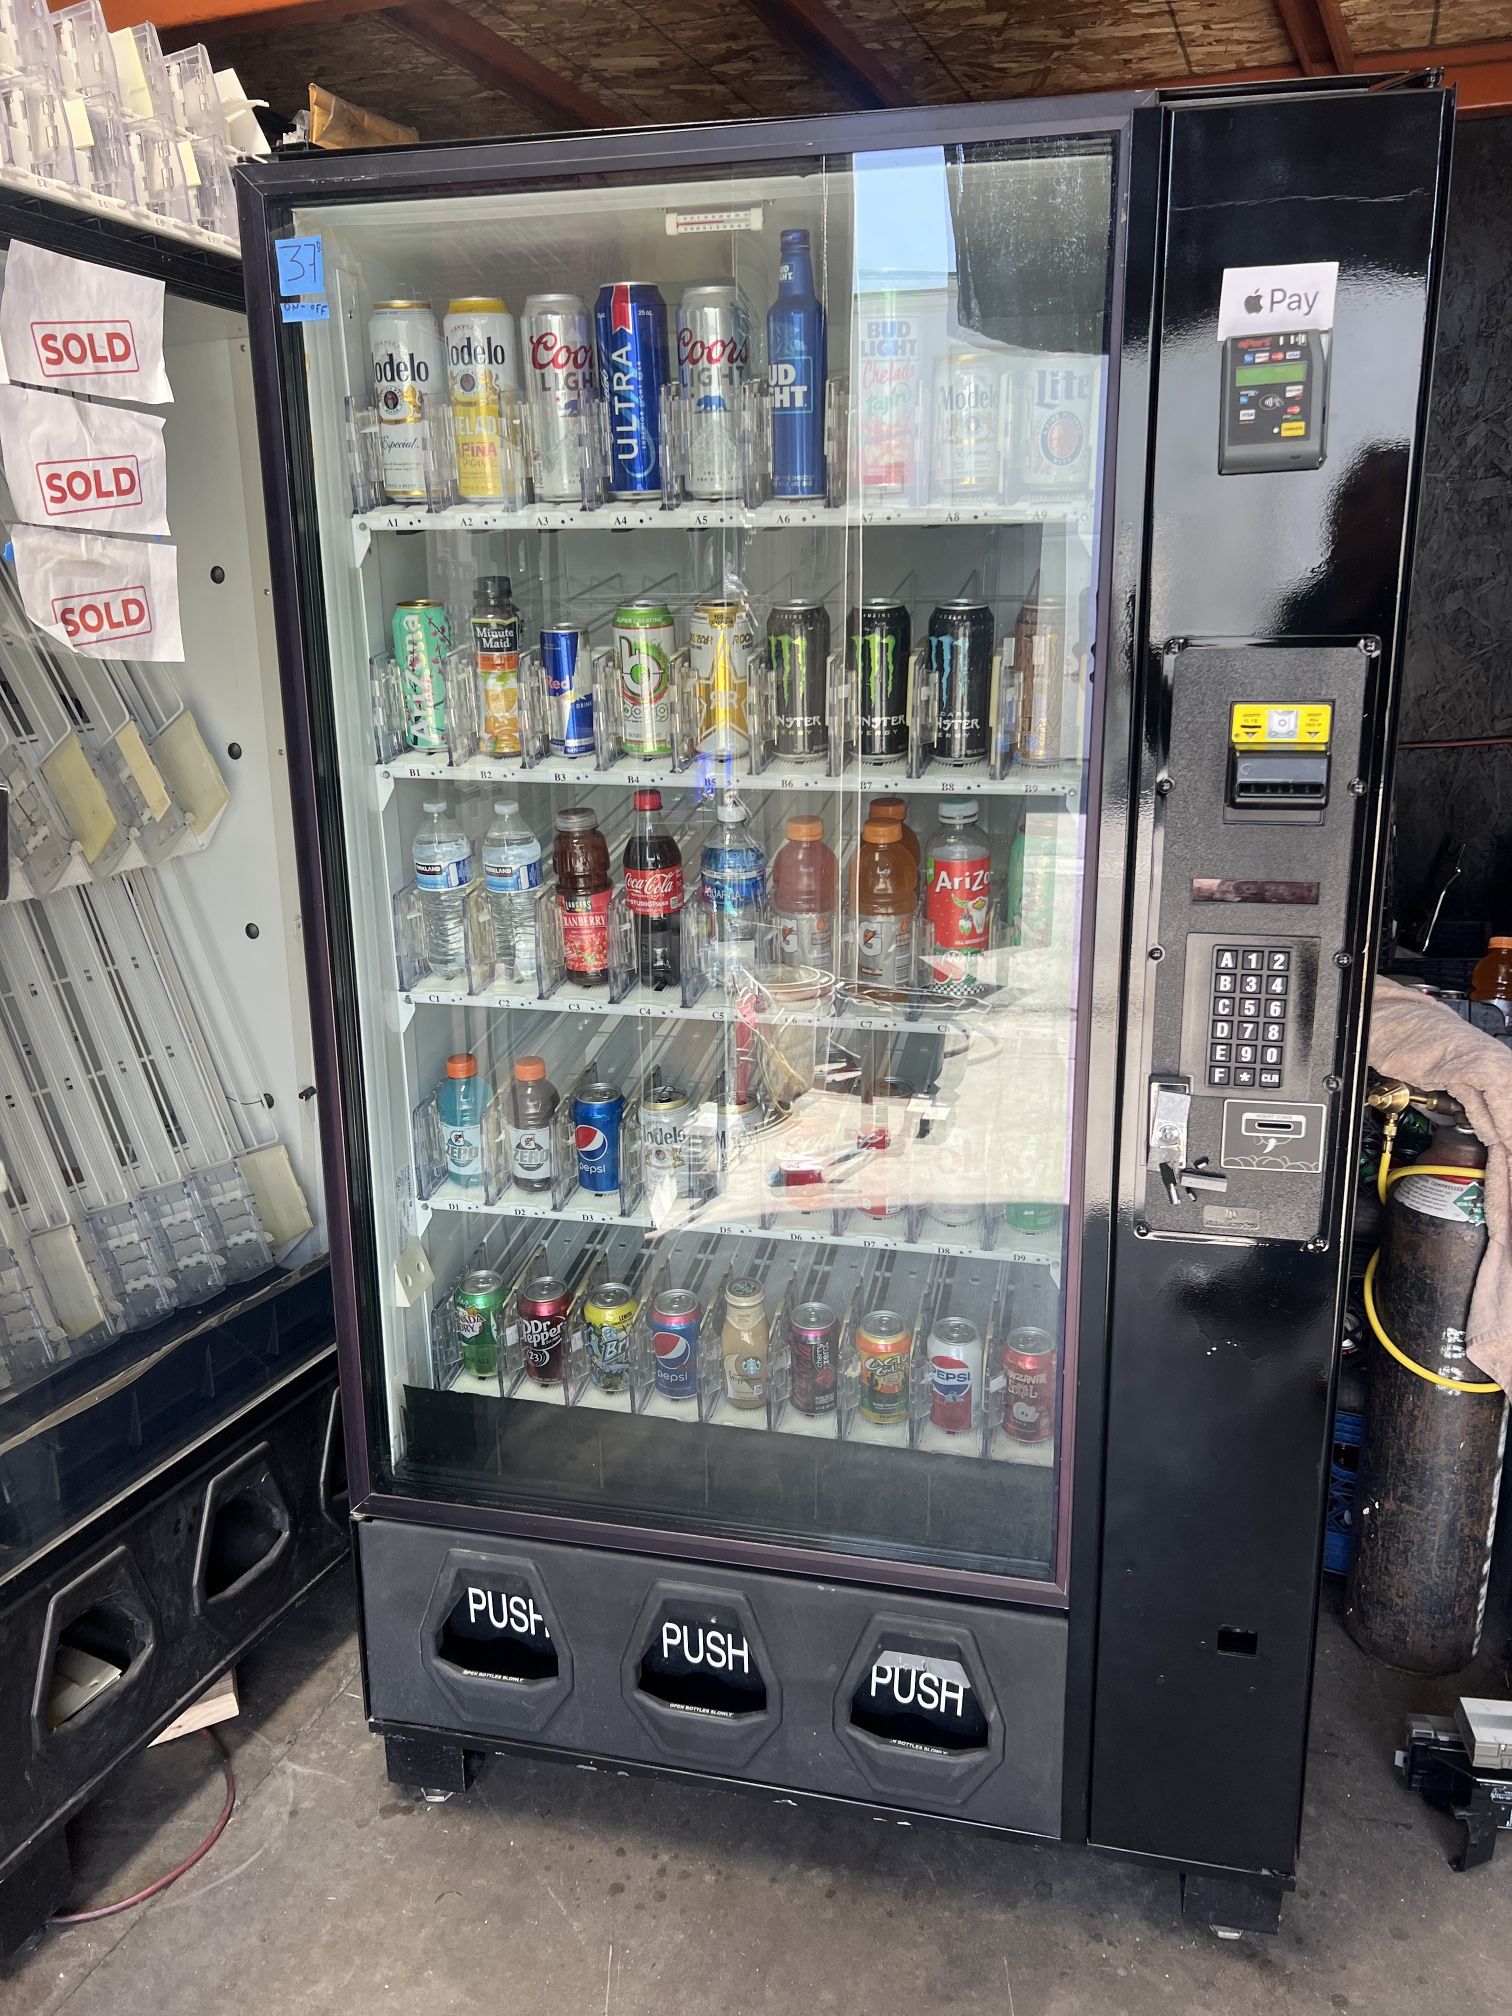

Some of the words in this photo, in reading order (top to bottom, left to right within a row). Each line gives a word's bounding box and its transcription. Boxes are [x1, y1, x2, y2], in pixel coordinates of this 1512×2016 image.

[1269, 288, 1320, 316] Pay
[867, 321, 912, 339] BUD
[40, 331, 132, 366] SOLD
[677, 327, 749, 366] Coors
[861, 339, 918, 357] LIGHT
[1035, 369, 1092, 410] Lite
[611, 342, 640, 460] ULTRA
[44, 466, 137, 504] SOLD
[615, 517, 627, 525] A4
[695, 516, 708, 525] A5
[777, 515, 790, 524] A6
[945, 513, 960, 522] A8
[1033, 511, 1047, 520] A9
[387, 518, 399, 527] A1
[461, 518, 473, 527] A2
[536, 517, 549, 526] A3
[61, 598, 146, 637] SOLD
[475, 627, 514, 638] Minute
[482, 638, 510, 648] Maid
[777, 715, 822, 728] NSTER
[409, 768, 421, 777] B1
[480, 771, 492, 779] B2
[554, 773, 566, 781] B3
[628, 775, 639, 784] B4
[704, 778, 716, 787] B5
[781, 780, 794, 788] B6
[860, 781, 872, 790] B7
[941, 782, 955, 791] B8
[1024, 784, 1038, 793] B9
[935, 870, 991, 893] AriZo
[1220, 952, 1233, 968] A
[1248, 953, 1257, 969] 1
[1273, 954, 1285, 970] 2
[1219, 975, 1232, 991] B
[1245, 976, 1257, 992] 3
[1271, 977, 1283, 993] 4
[429, 995, 440, 1003] C1
[568, 1004, 580, 1012] C3
[1218, 999, 1230, 1015] C
[1244, 1000, 1255, 1016] 5
[1269, 1001, 1281, 1017] 6
[712, 1011, 724, 1020] C5
[860, 1020, 872, 1029] C7
[1216, 1022, 1228, 1038] D
[1242, 1023, 1254, 1039] 7
[1267, 1024, 1279, 1040] 8
[1215, 1045, 1227, 1061] E
[1241, 1046, 1252, 1062] 9
[1266, 1048, 1278, 1063] 0
[1214, 1068, 1225, 1083] F
[1261, 1074, 1279, 1083] CLR
[580, 1162, 606, 1174] pepsi
[790, 1233, 802, 1241] D6
[530, 1320, 551, 1334] Dr
[529, 1351, 540, 1362] 23
[816, 1343, 825, 1368] cherry
[657, 1369, 688, 1382] pepsi
[931, 1366, 971, 1382] PEPSI
[468, 1586, 550, 1638] PUSH
[662, 1621, 749, 1674] PUSH
[479, 1672, 502, 1680] BOTTLES
[870, 1665, 964, 1717] PUSH
[685, 1705, 710, 1714] BOTTLES
[710, 1709, 734, 1717] SLOWLY
[897, 1739, 923, 1750] BOTTLES
